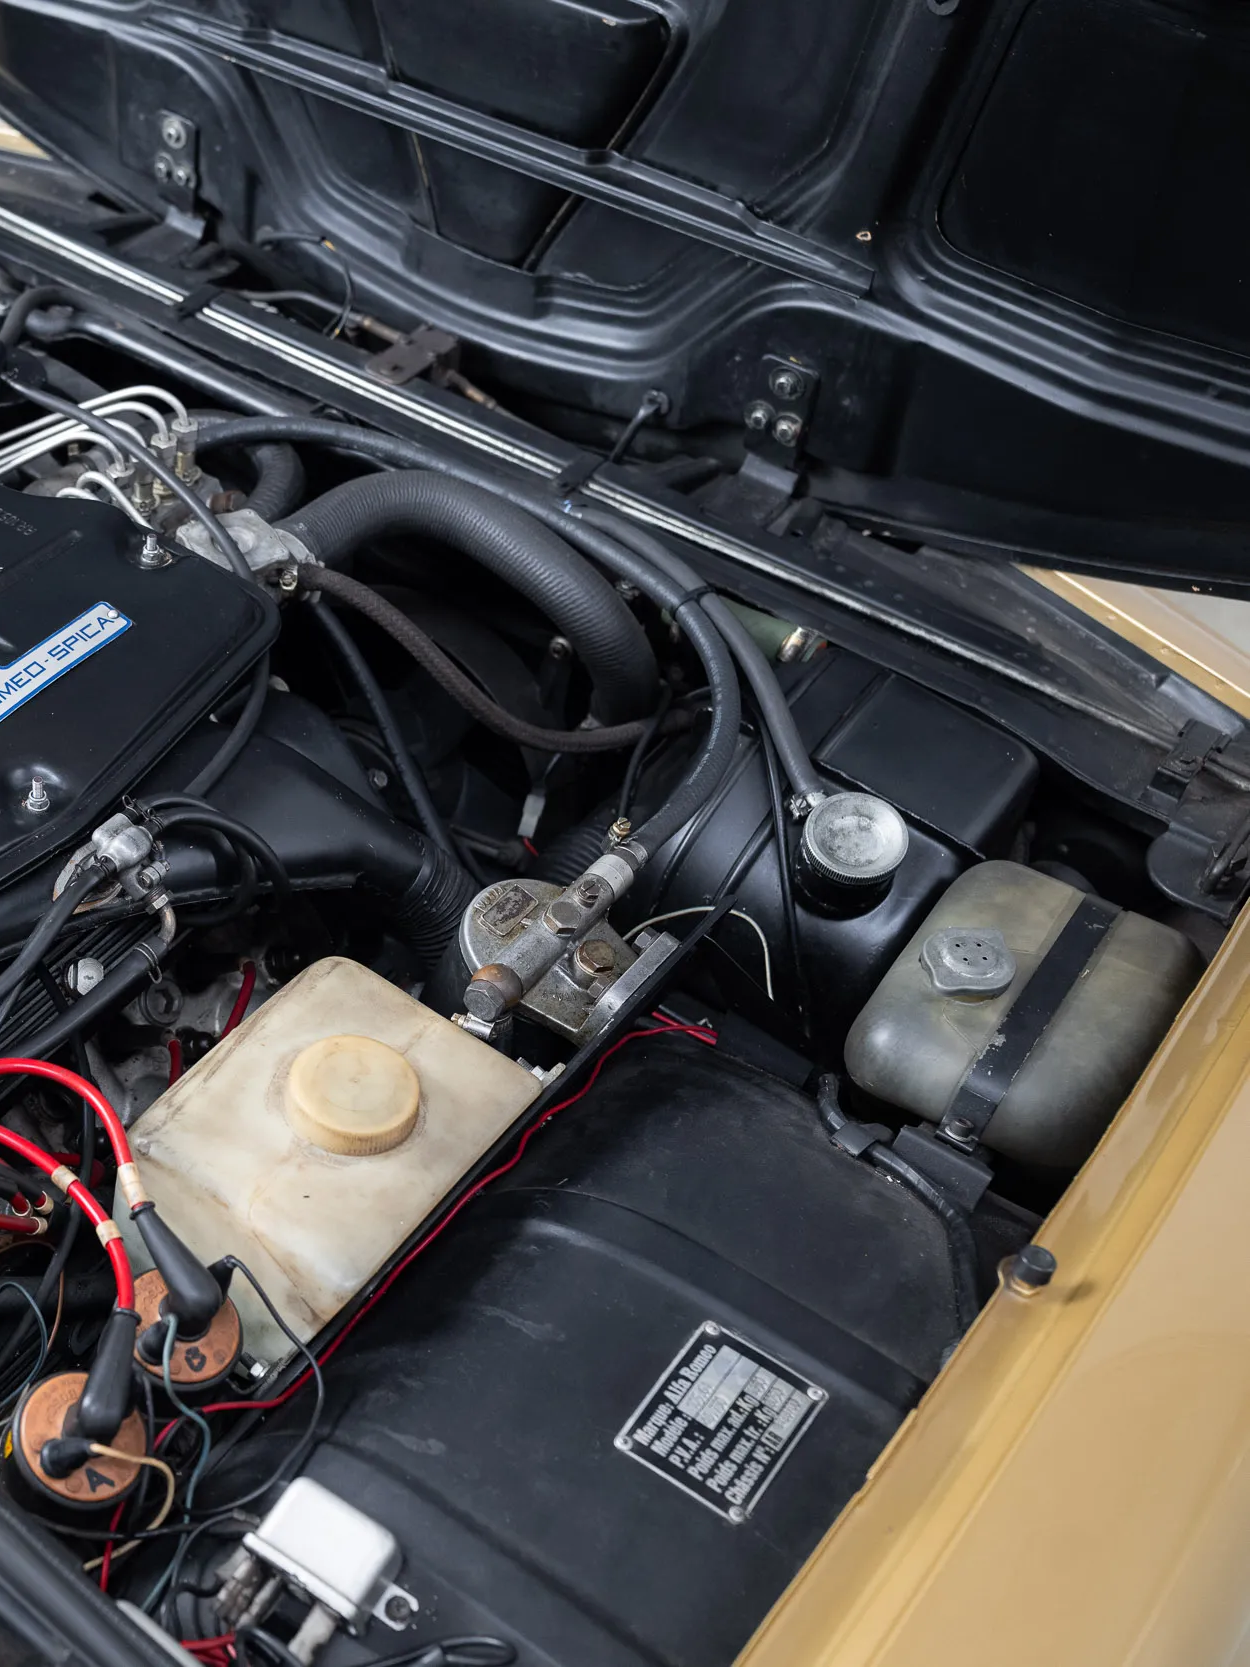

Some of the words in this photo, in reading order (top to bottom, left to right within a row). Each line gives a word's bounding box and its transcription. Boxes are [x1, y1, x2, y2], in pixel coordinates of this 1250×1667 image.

[633, 1403, 678, 1446] Marque:
[664, 1378, 692, 1405] Alfa
[685, 1344, 717, 1382] Romeo
[85, 1467, 115, 1492] A
[686, 1448, 719, 1481] Poids
[705, 1460, 738, 1493] Poids
